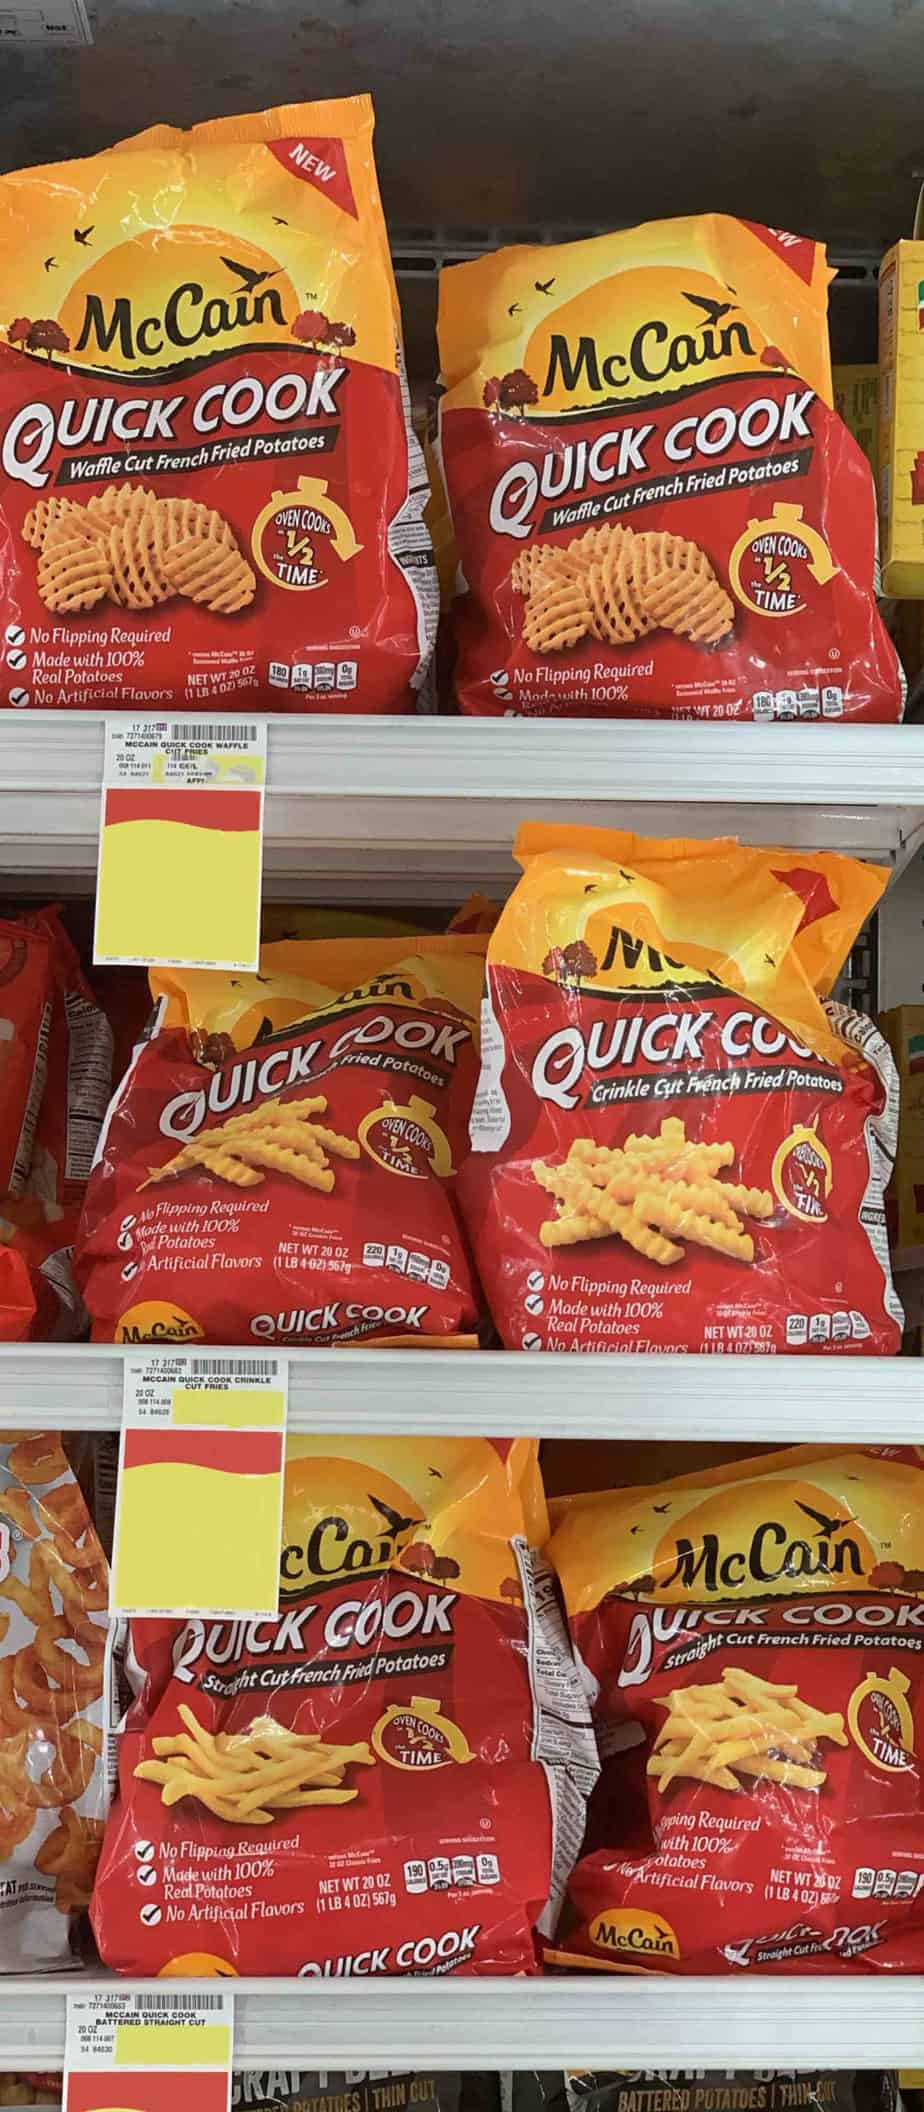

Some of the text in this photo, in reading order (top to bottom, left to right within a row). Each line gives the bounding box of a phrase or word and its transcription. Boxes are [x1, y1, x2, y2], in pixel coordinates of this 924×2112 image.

[288, 143, 336, 182] NEW
[74, 283, 288, 359] McCain
[542, 320, 757, 397] McCain
[1, 367, 350, 487] QUICK COOK
[70, 435, 325, 479] Waffle Cut French Fried Potatoes
[489, 390, 816, 538] QUICK COOK
[552, 458, 800, 527] Waffle Cut French Fried Potatoes
[275, 509, 331, 534] OVEN COOKS
[751, 536, 808, 559] OVEN COOKS
[30, 626, 171, 647] No Flipping Required
[32, 651, 145, 667] Made with 100%
[32, 669, 123, 684] Real Potatoes
[187, 665, 255, 687] NET WT OZ
[513, 659, 654, 685] No Flipping Required
[34, 687, 173, 706] No Artificial Flavors
[591, 685, 629, 701] 100%
[383, 1055, 445, 1087] Potatoes
[532, 1011, 713, 1110] QUICK
[159, 1014, 471, 1141] QUICK COOK
[593, 1070, 843, 1103] Crinkle Cut French Fried Potatoes
[382, 1119, 406, 1136] OVEN
[156, 1199, 269, 1217] Flipping Required
[170, 1218, 240, 1233] with 100%
[158, 1235, 216, 1249] Potatoes
[278, 1242, 349, 1258] NET WT OZ
[147, 1253, 263, 1272] Artificial Flavors
[548, 1274, 692, 1298] No Flipping Required
[550, 1298, 663, 1318] Made with 100%
[250, 1302, 428, 1341] QUICK COOK
[547, 1315, 640, 1334] Real Potatoes
[704, 1325, 773, 1339] NET WT OZ
[570, 1337, 689, 1353] Artificial Flavors
[660, 1521, 866, 1591] McCain
[172, 1591, 456, 1683] QUICK COOK
[617, 1603, 924, 1688] QUICK COOK
[663, 1633, 922, 1670] Straight Cut French Fried Potatoes
[260, 1652, 446, 1687] Cut French Fried Potatoes
[393, 1715, 416, 1729] OVEN
[399, 1750, 442, 1765] TIME
[698, 1810, 761, 1833] Required
[159, 1834, 300, 1861] No Flipping Required
[691, 1836, 733, 1854] 100%
[162, 1859, 274, 1883] Made with 100%
[407, 1864, 423, 1877] 190
[634, 1866, 754, 1895] Artificial Flavors
[770, 1869, 841, 1890] NET WT OZ
[164, 1883, 253, 1900] Real Potatoes
[319, 1873, 391, 1894] NET WT 20 OZ
[166, 1900, 305, 1923] No Artificial Flavors
[328, 1896, 342, 1911] LB
[396, 1924, 480, 1967] COOK
[595, 1921, 673, 1953] McCain
[617, 2086, 768, 2112] BATTERED POTATOES
